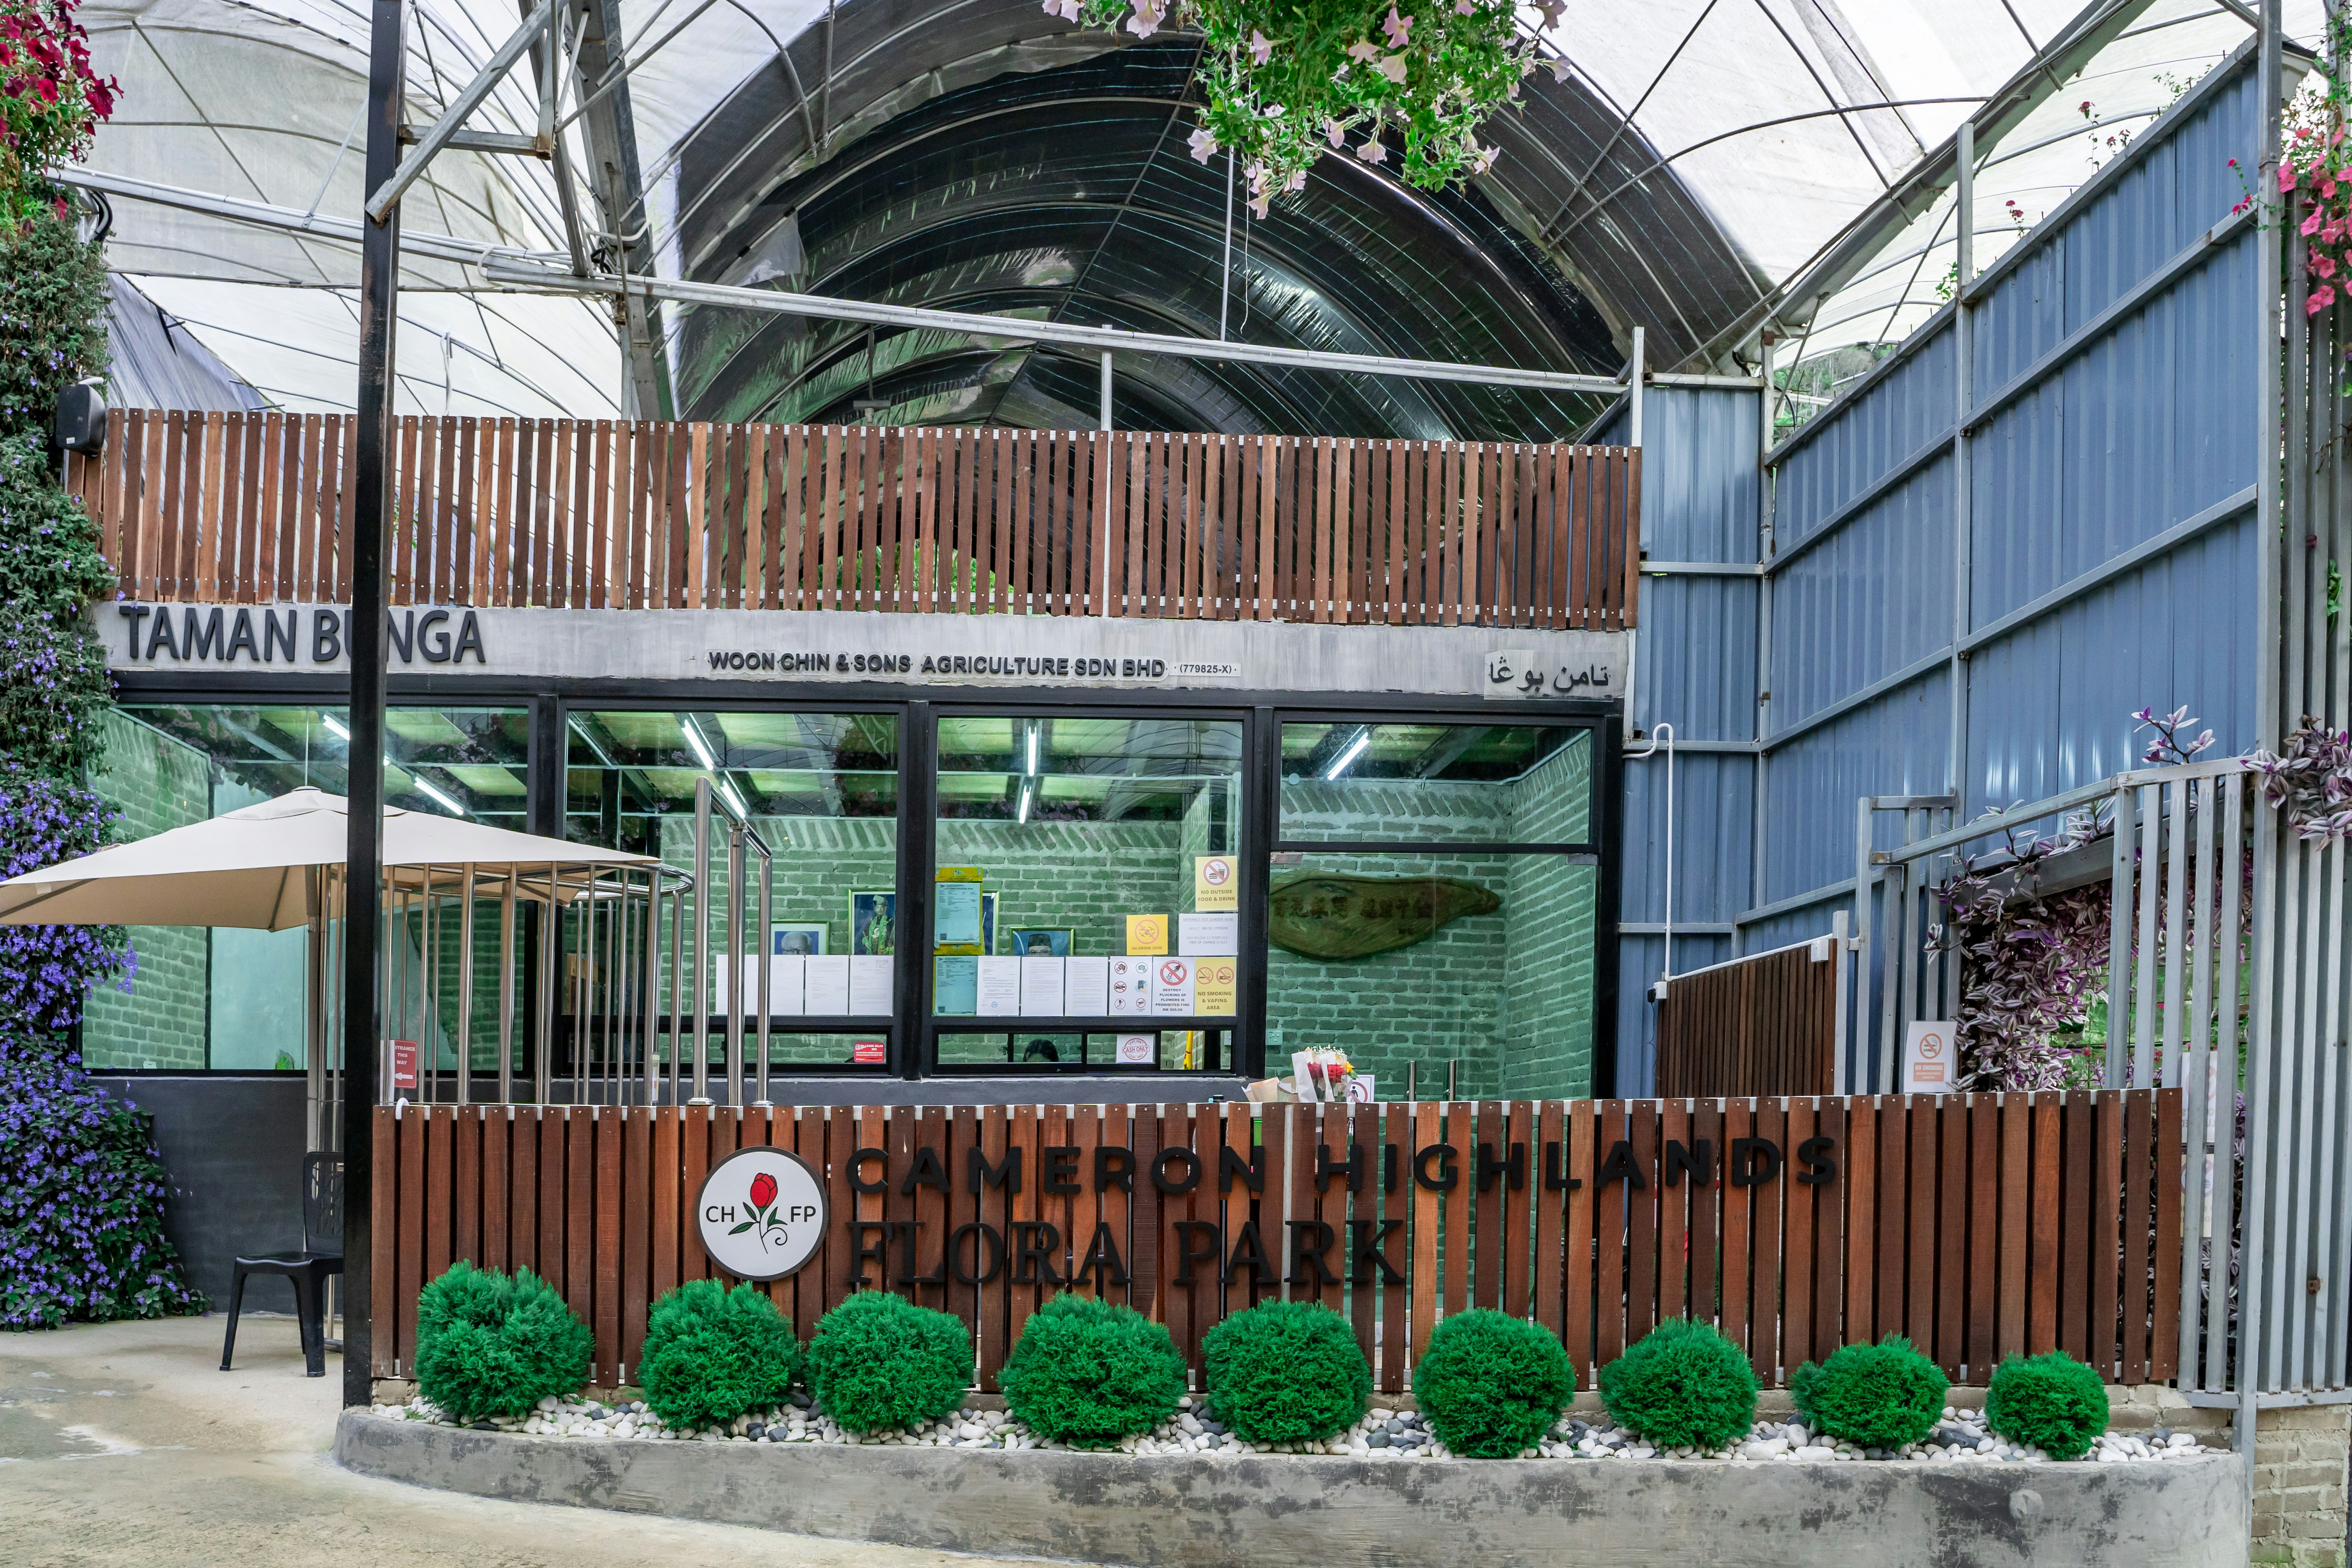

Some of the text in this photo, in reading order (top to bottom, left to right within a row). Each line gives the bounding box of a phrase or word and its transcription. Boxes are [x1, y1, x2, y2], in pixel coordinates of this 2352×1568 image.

[119, 605, 486, 662] TAMAN BNGA
[709, 652, 1232, 677] WOON CHIN & SONS AGRICULTURE SDN BHD (779825-X)
[1553, 663, 1609, 693] تامن
[845, 1136, 1837, 1194] CAMERON HIGHLANDS
[706, 1206, 816, 1223] CH FP
[846, 1219, 1406, 1285] FLORA PARK
